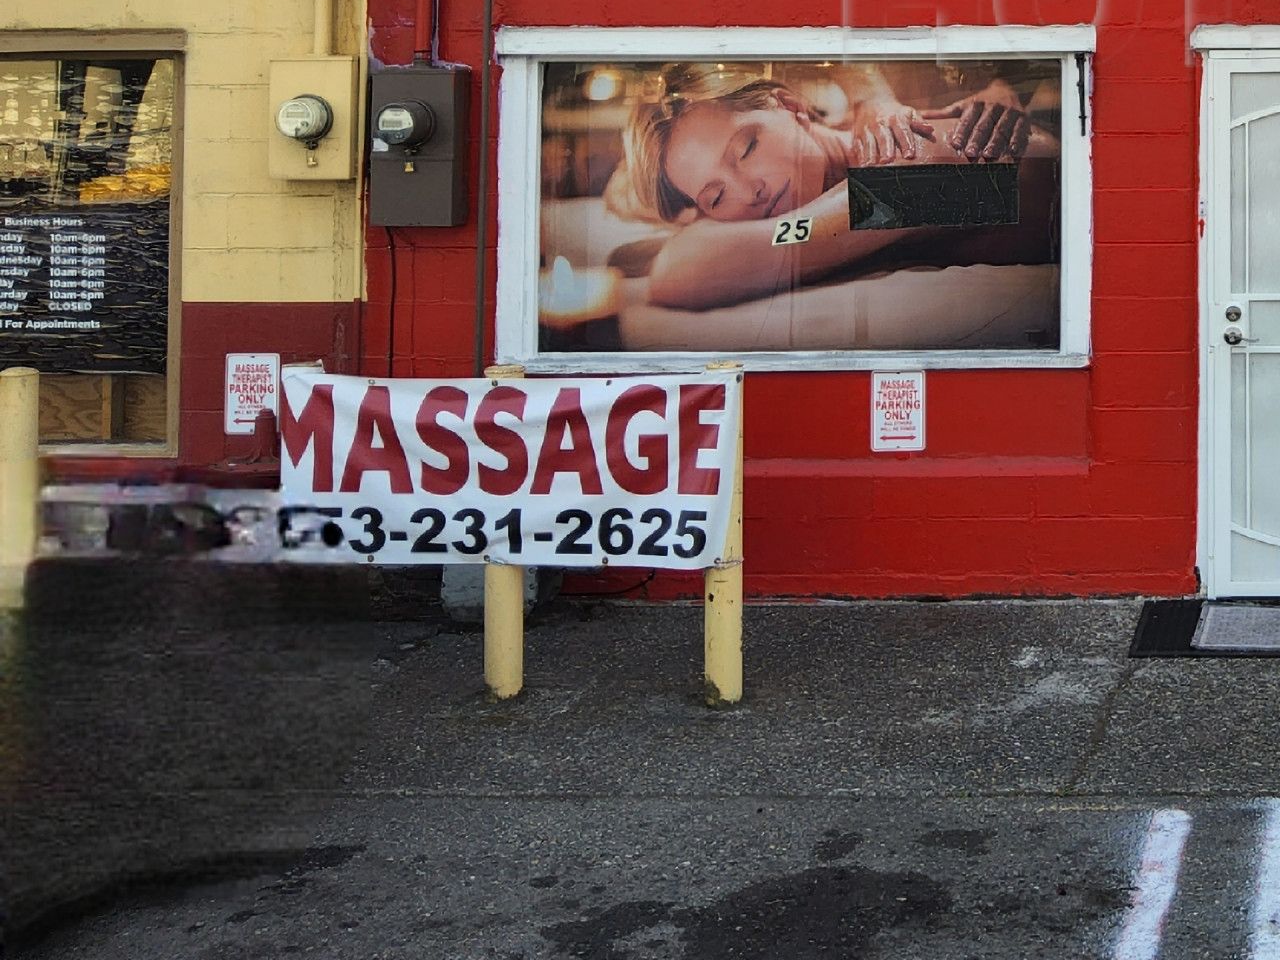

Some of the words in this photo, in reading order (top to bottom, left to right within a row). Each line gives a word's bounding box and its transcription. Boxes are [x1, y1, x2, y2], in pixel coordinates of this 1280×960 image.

[5, 217, 50, 226] Business
[775, 219, 810, 243] 25
[50, 233, 106, 243] 10am-6pm
[50, 244, 105, 254] 10am-6pm
[50, 256, 105, 266] 10am-6pm
[50, 268, 105, 278] 10am-6pm
[49, 280, 105, 289] 10am-6pm
[49, 291, 104, 300] 10am-6pm
[48, 302, 92, 311] CLOSED
[5, 320, 24, 328] For
[25, 320, 101, 330] Appointments
[235, 364, 270, 373] MASSAGE
[229, 384, 274, 393] PARKING
[880, 380, 915, 389] MASSAGE
[238, 394, 265, 404] ONLY
[875, 400, 920, 410] PARKING
[884, 410, 912, 420] ONLY
[280, 383, 726, 496] MASSAGE
